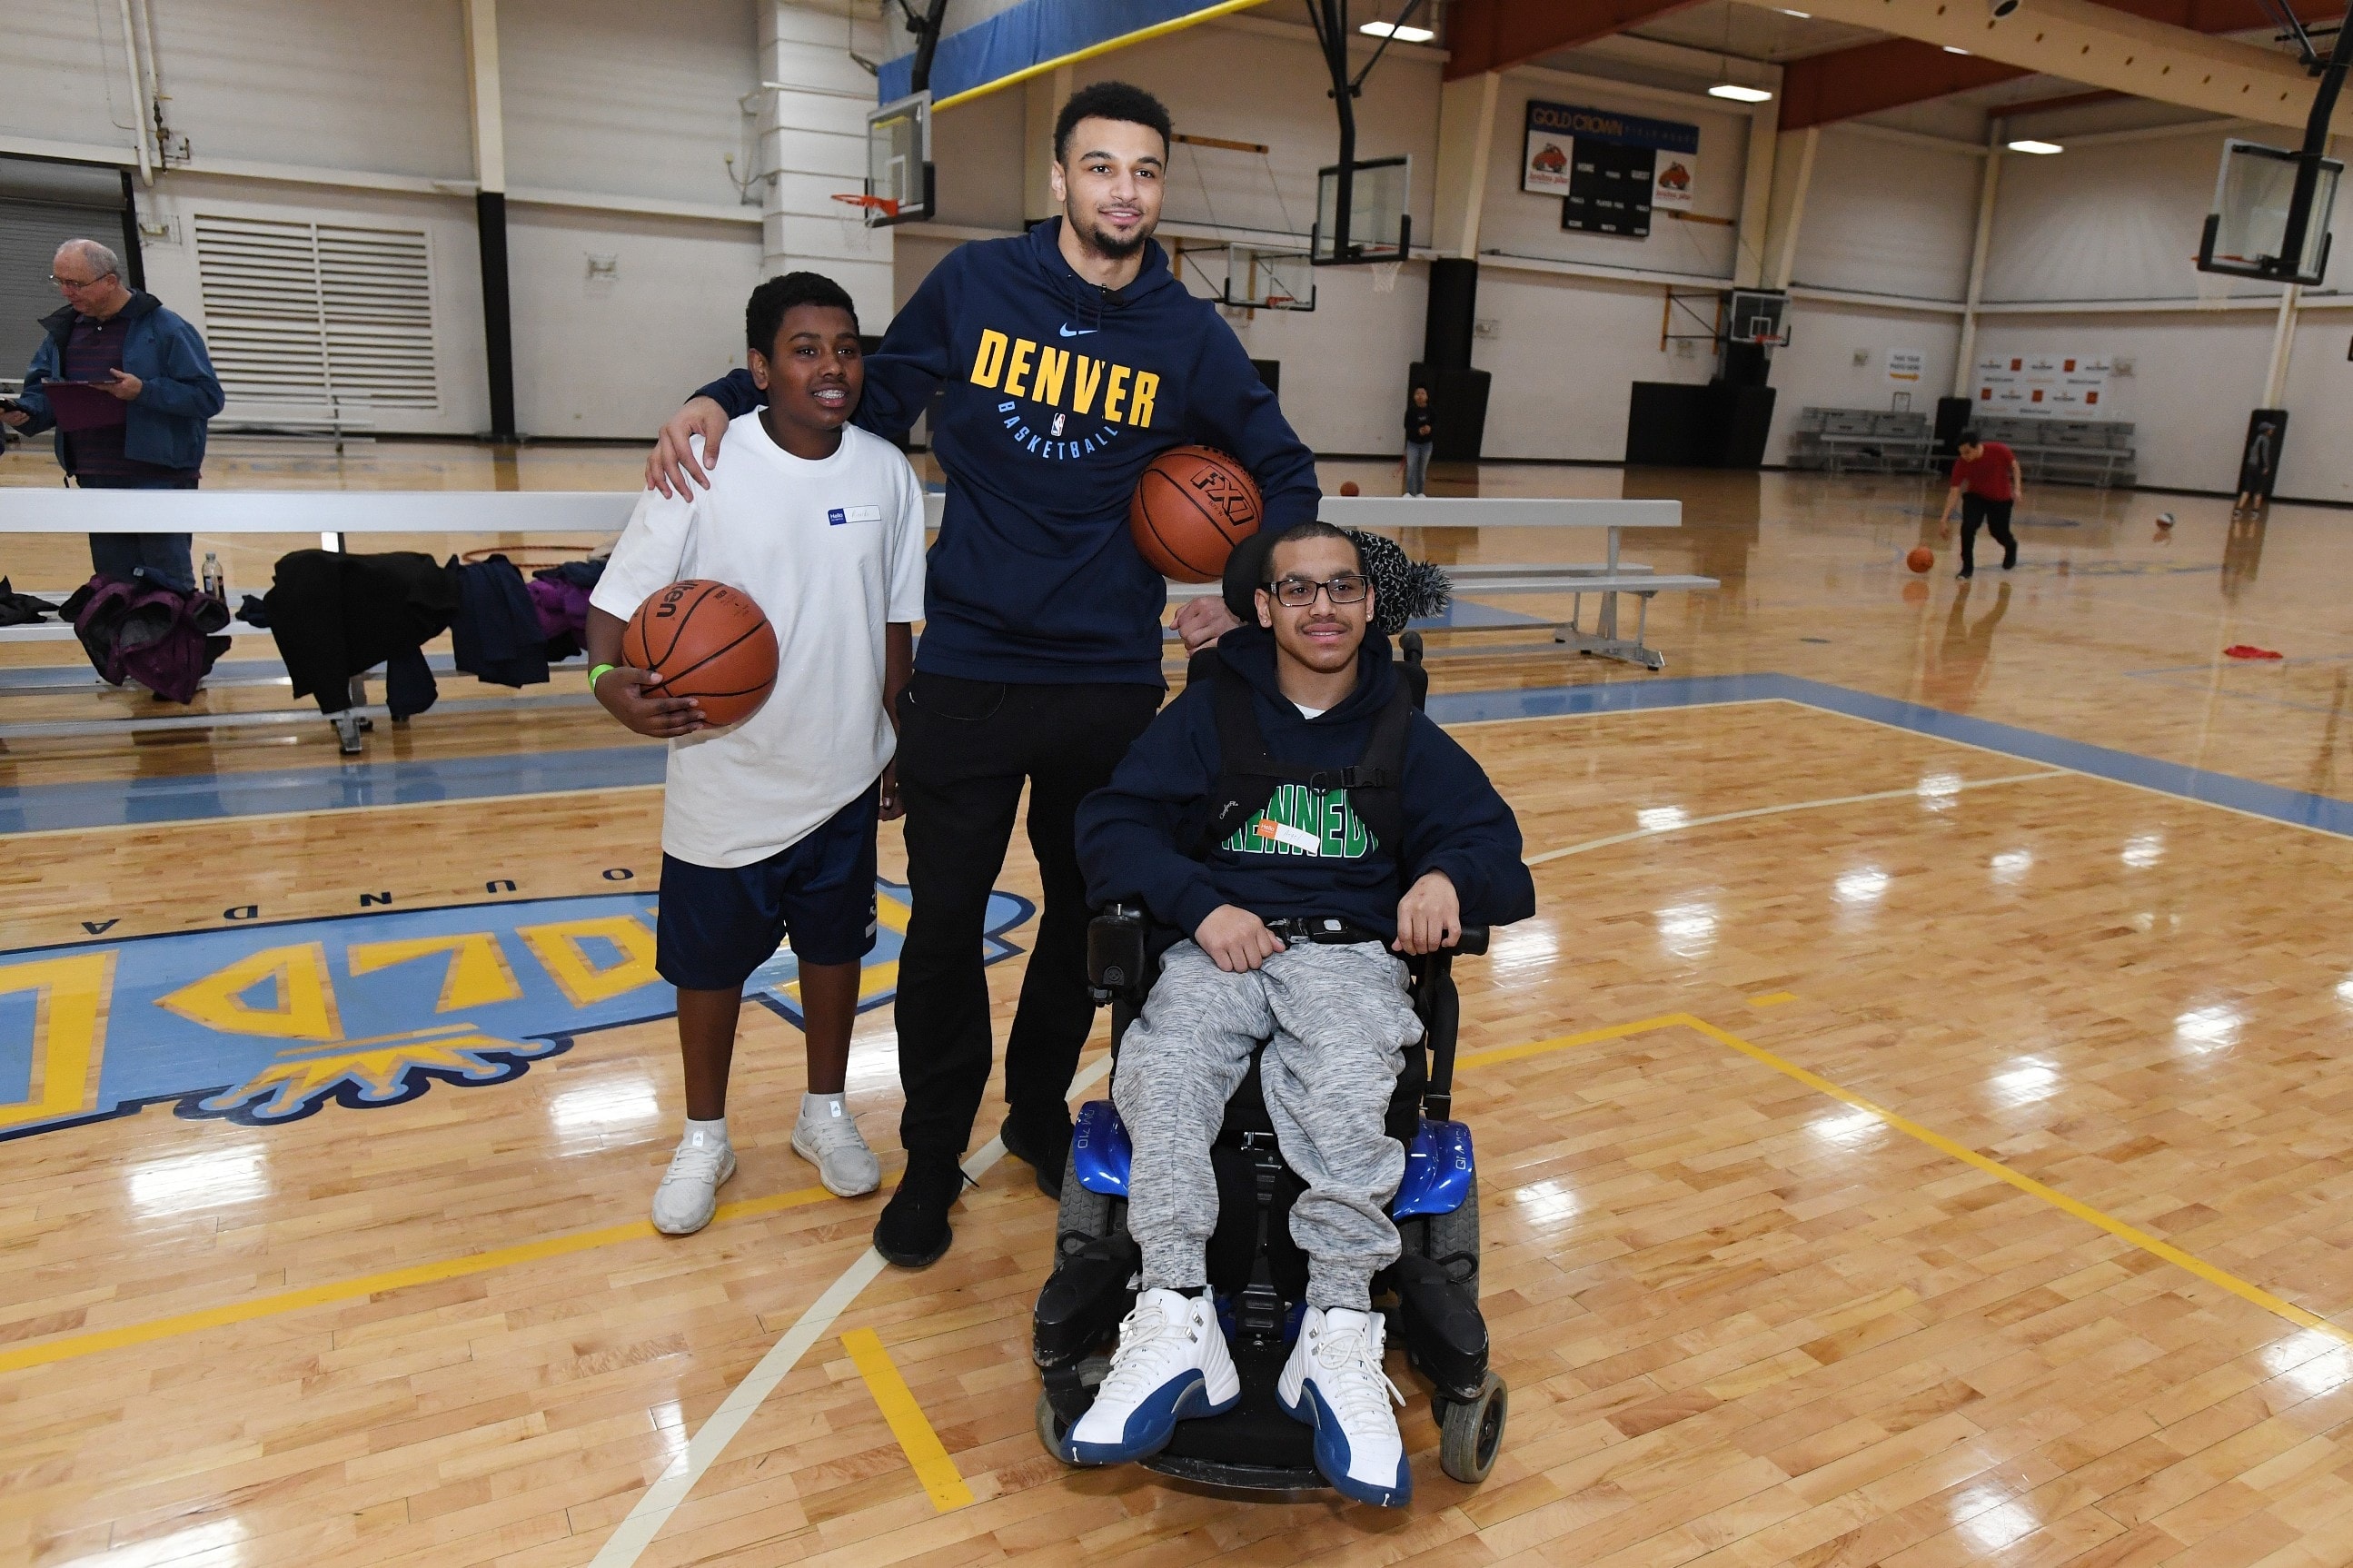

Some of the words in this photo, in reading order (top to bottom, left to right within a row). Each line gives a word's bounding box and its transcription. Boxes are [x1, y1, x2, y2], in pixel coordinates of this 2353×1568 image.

[1533, 107, 1573, 127] GOLD
[1573, 112, 1623, 136] CROWN
[970, 328, 1160, 429] DENVER
[998, 401, 1118, 461] BASKETBALL
[1221, 784, 1379, 858] ENNED
[1260, 822, 1275, 832] Hello
